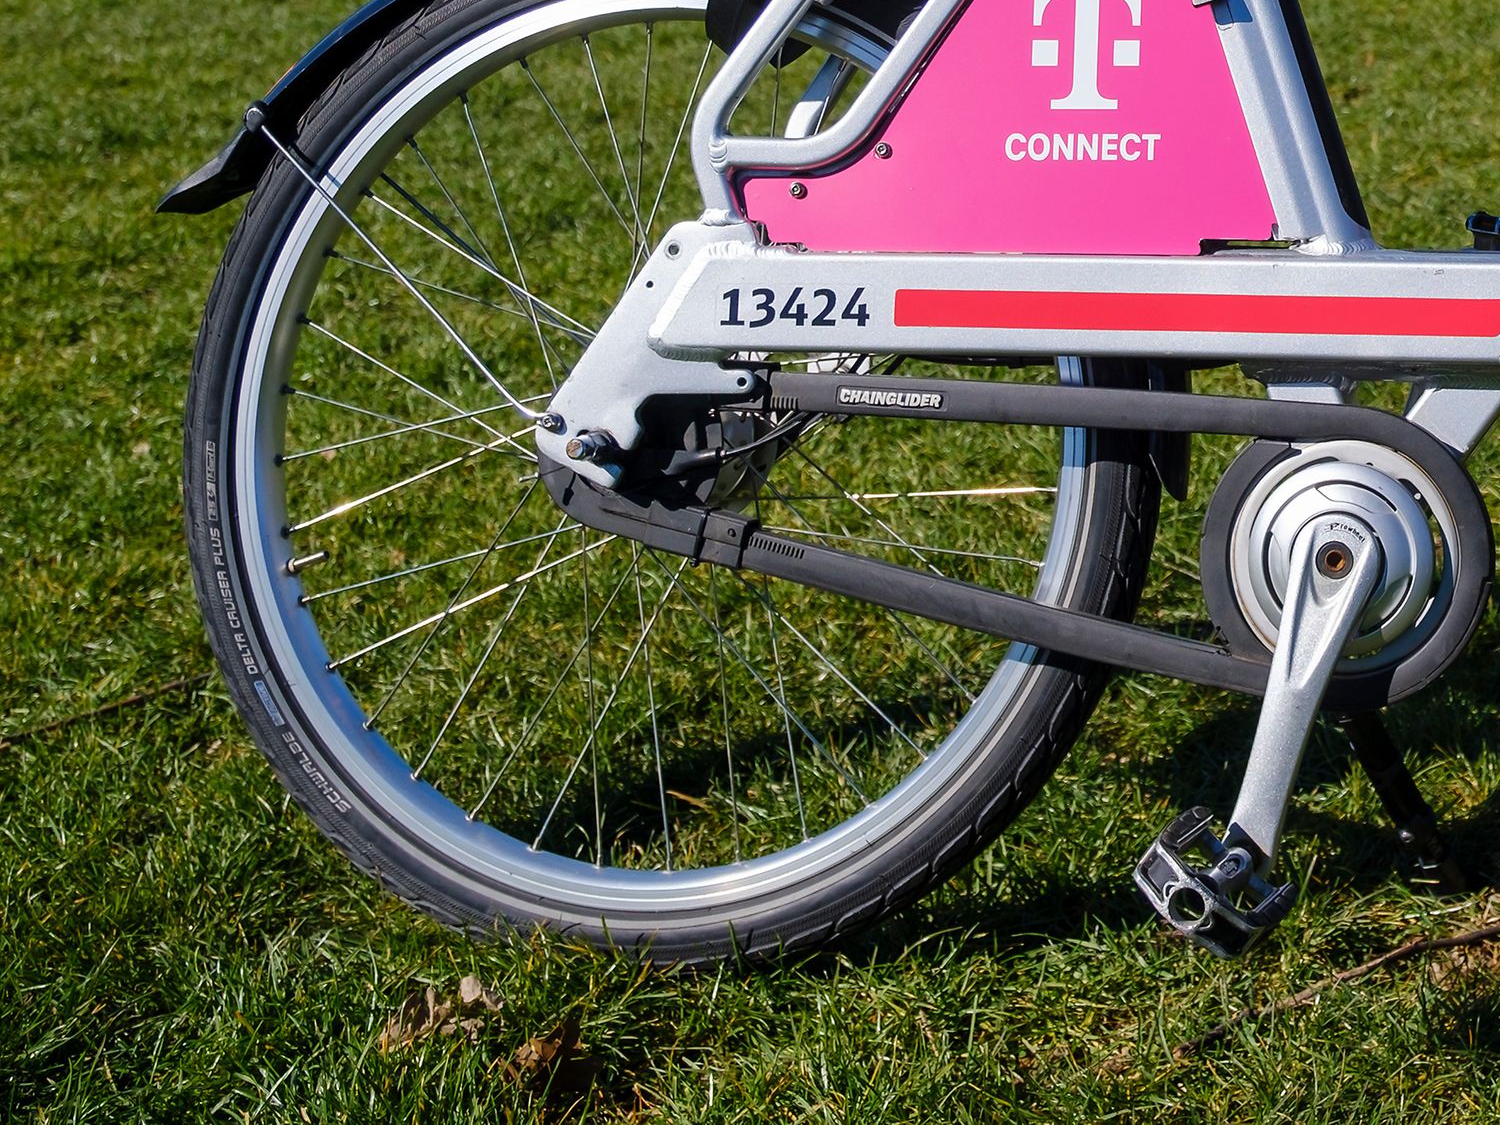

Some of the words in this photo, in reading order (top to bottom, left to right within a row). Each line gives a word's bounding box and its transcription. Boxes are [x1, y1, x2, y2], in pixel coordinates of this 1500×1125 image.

[1004, 132, 1162, 163] CONNECT
[719, 286, 871, 329] 13424
[838, 387, 944, 409] CHAINGLIDER
[209, 527, 225, 566] PLUS
[216, 571, 242, 629] CRUISER
[233, 633, 259, 675] DELTA
[282, 731, 352, 814] SCHWALBE
